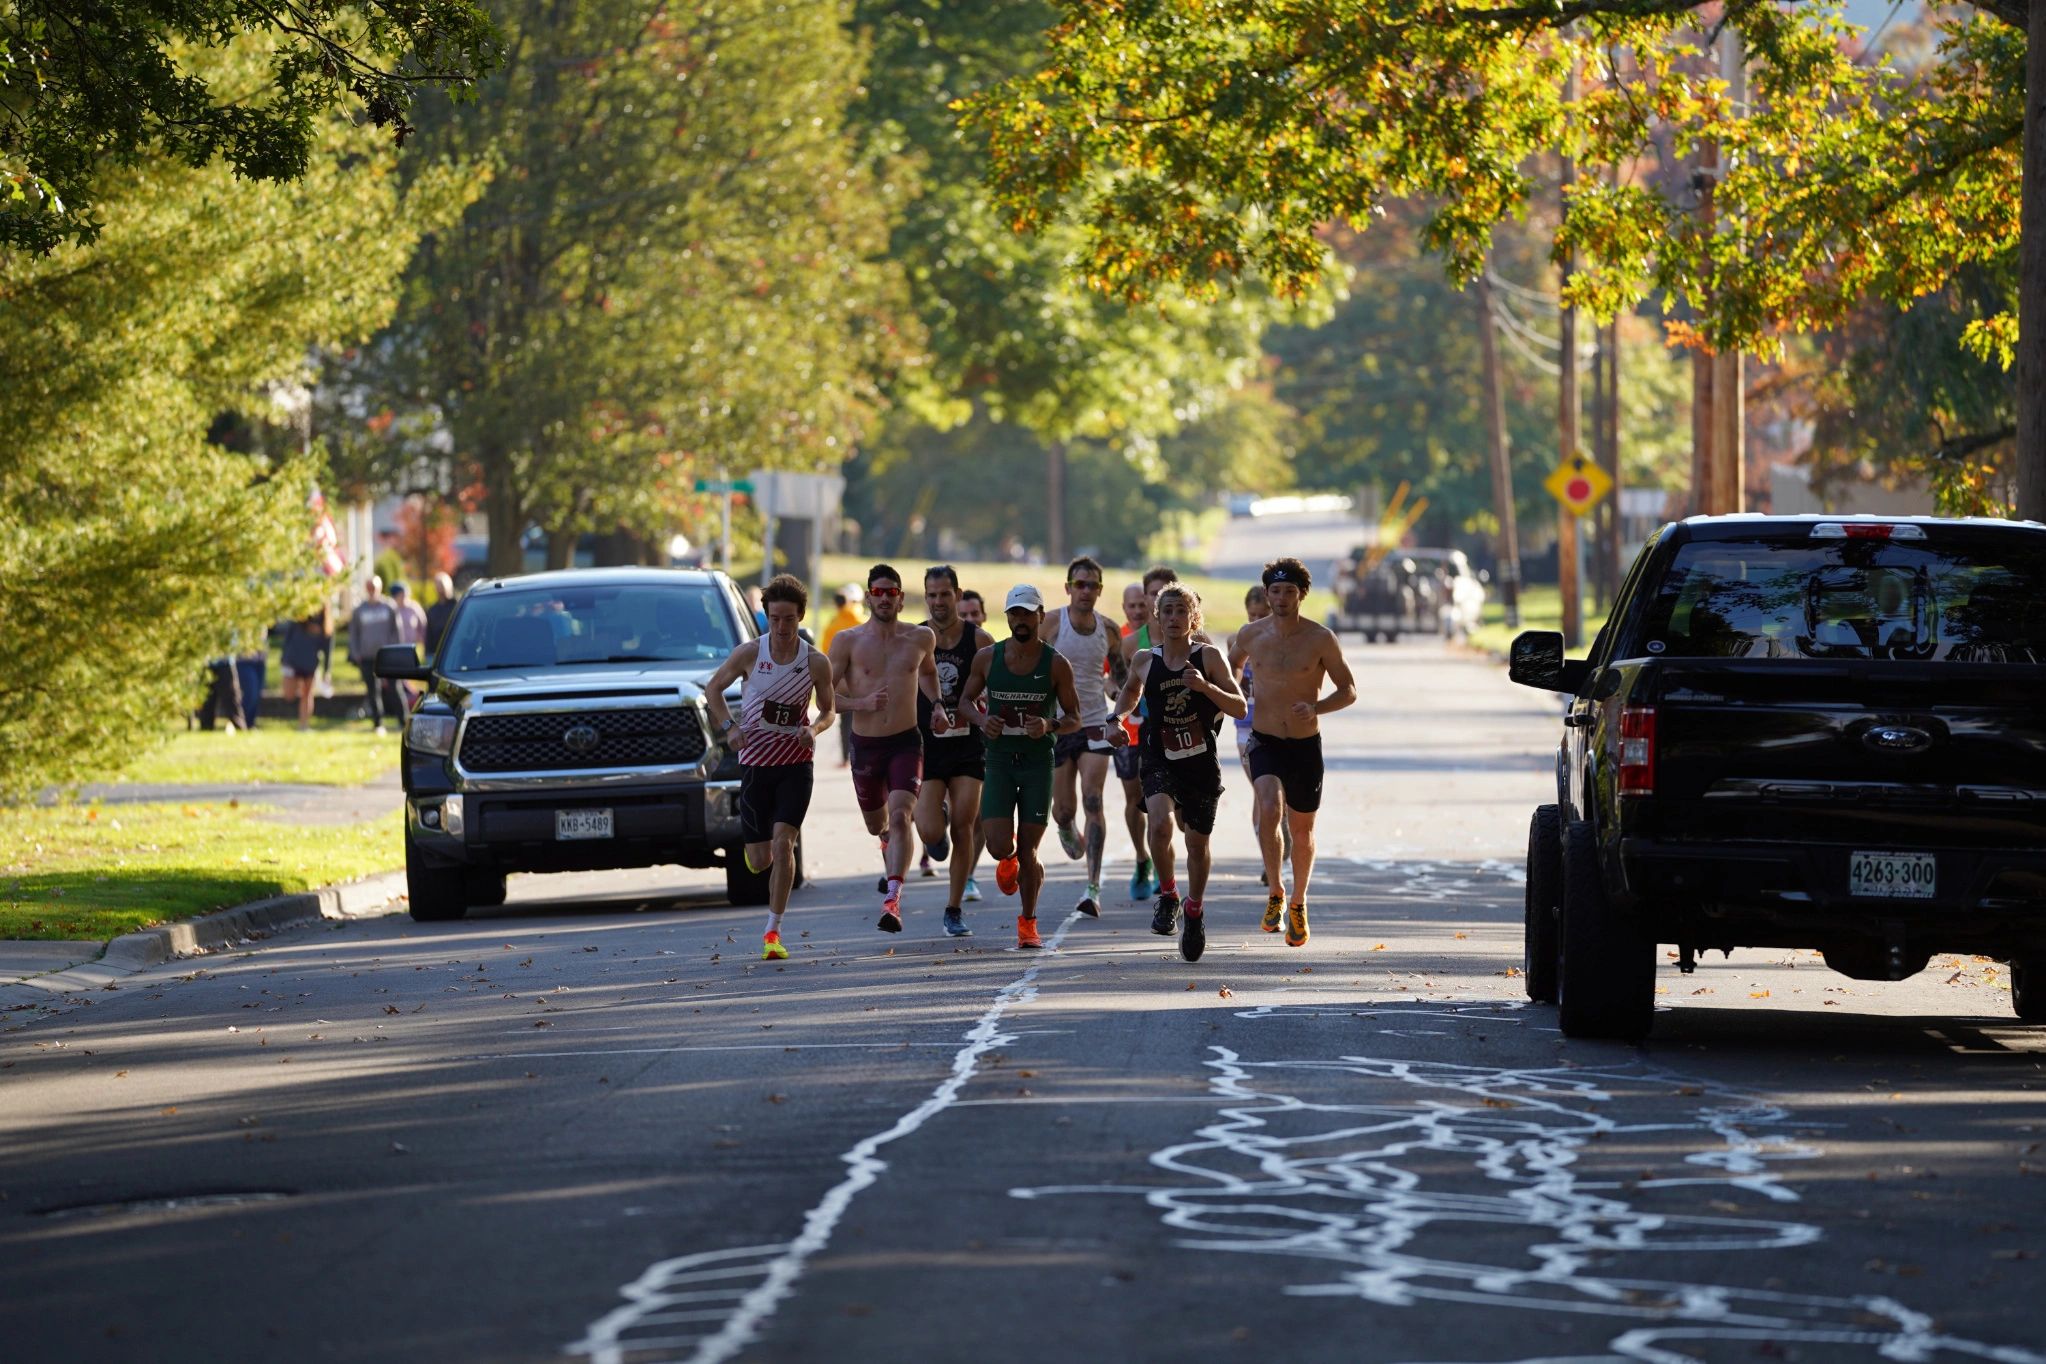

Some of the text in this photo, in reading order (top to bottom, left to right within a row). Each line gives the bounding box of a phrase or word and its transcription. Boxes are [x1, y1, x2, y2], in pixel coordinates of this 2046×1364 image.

[992, 691, 1046, 700] BINGHAMTON
[775, 710, 790, 725] 13
[1163, 713, 1198, 724] DISTANCE
[1175, 731, 1193, 748] 10
